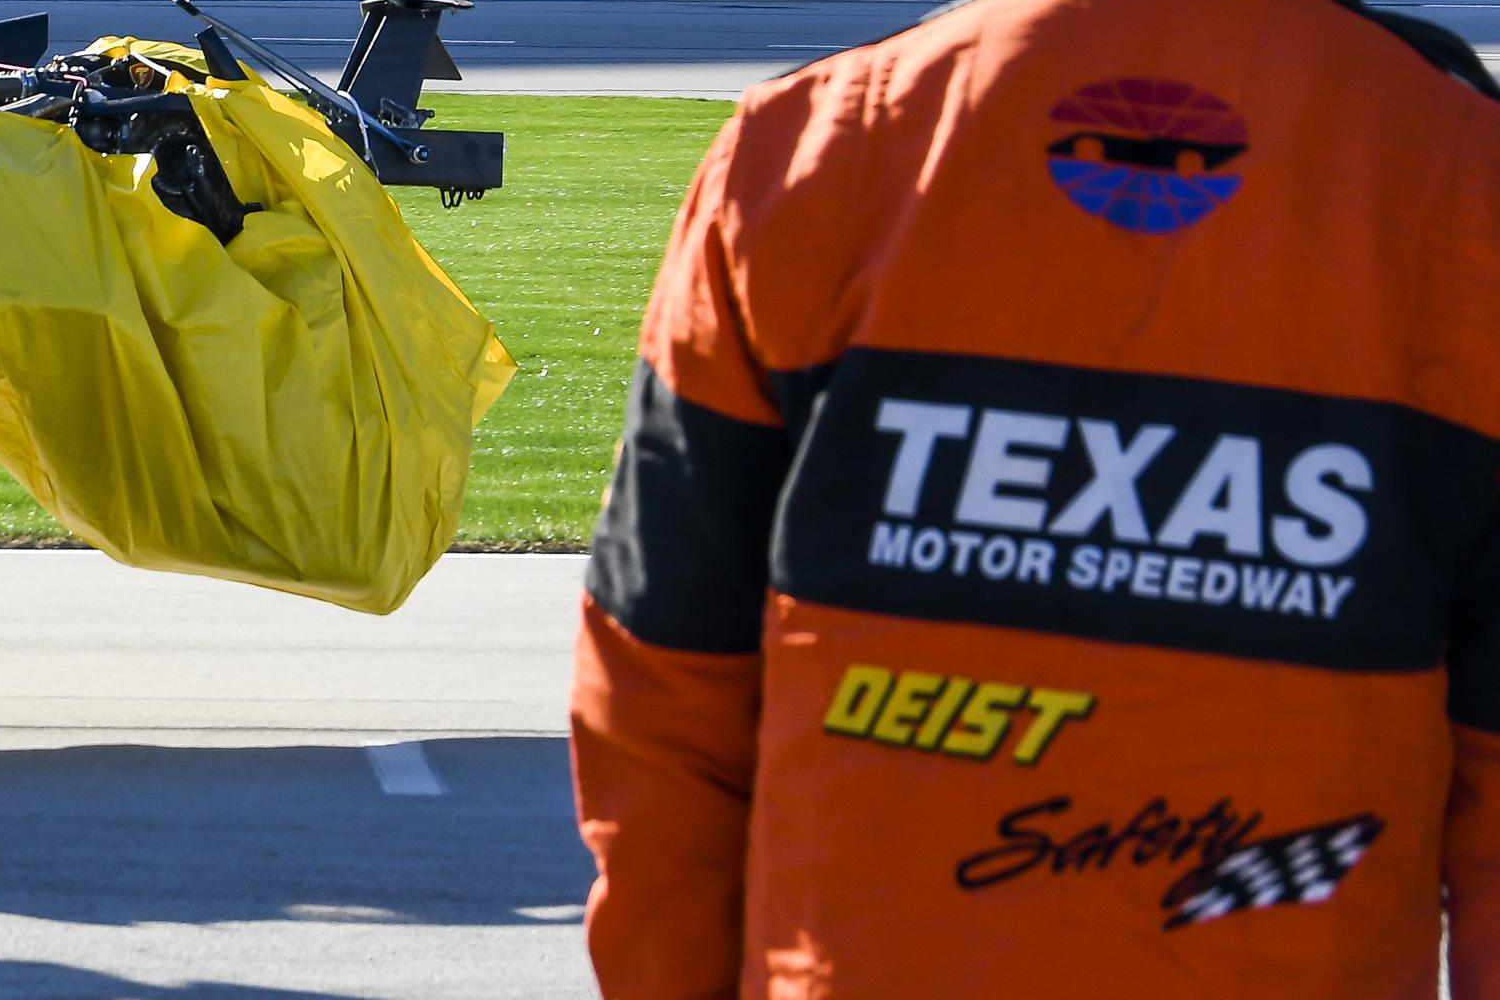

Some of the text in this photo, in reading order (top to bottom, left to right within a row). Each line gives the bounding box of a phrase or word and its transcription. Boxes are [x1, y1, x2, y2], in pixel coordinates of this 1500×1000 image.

[875, 398, 1373, 566] TEXAS
[868, 522, 1354, 619] MOTOR SPEEDWAY
[822, 664, 1095, 765] DEIST
[955, 797, 1263, 909] Safety
